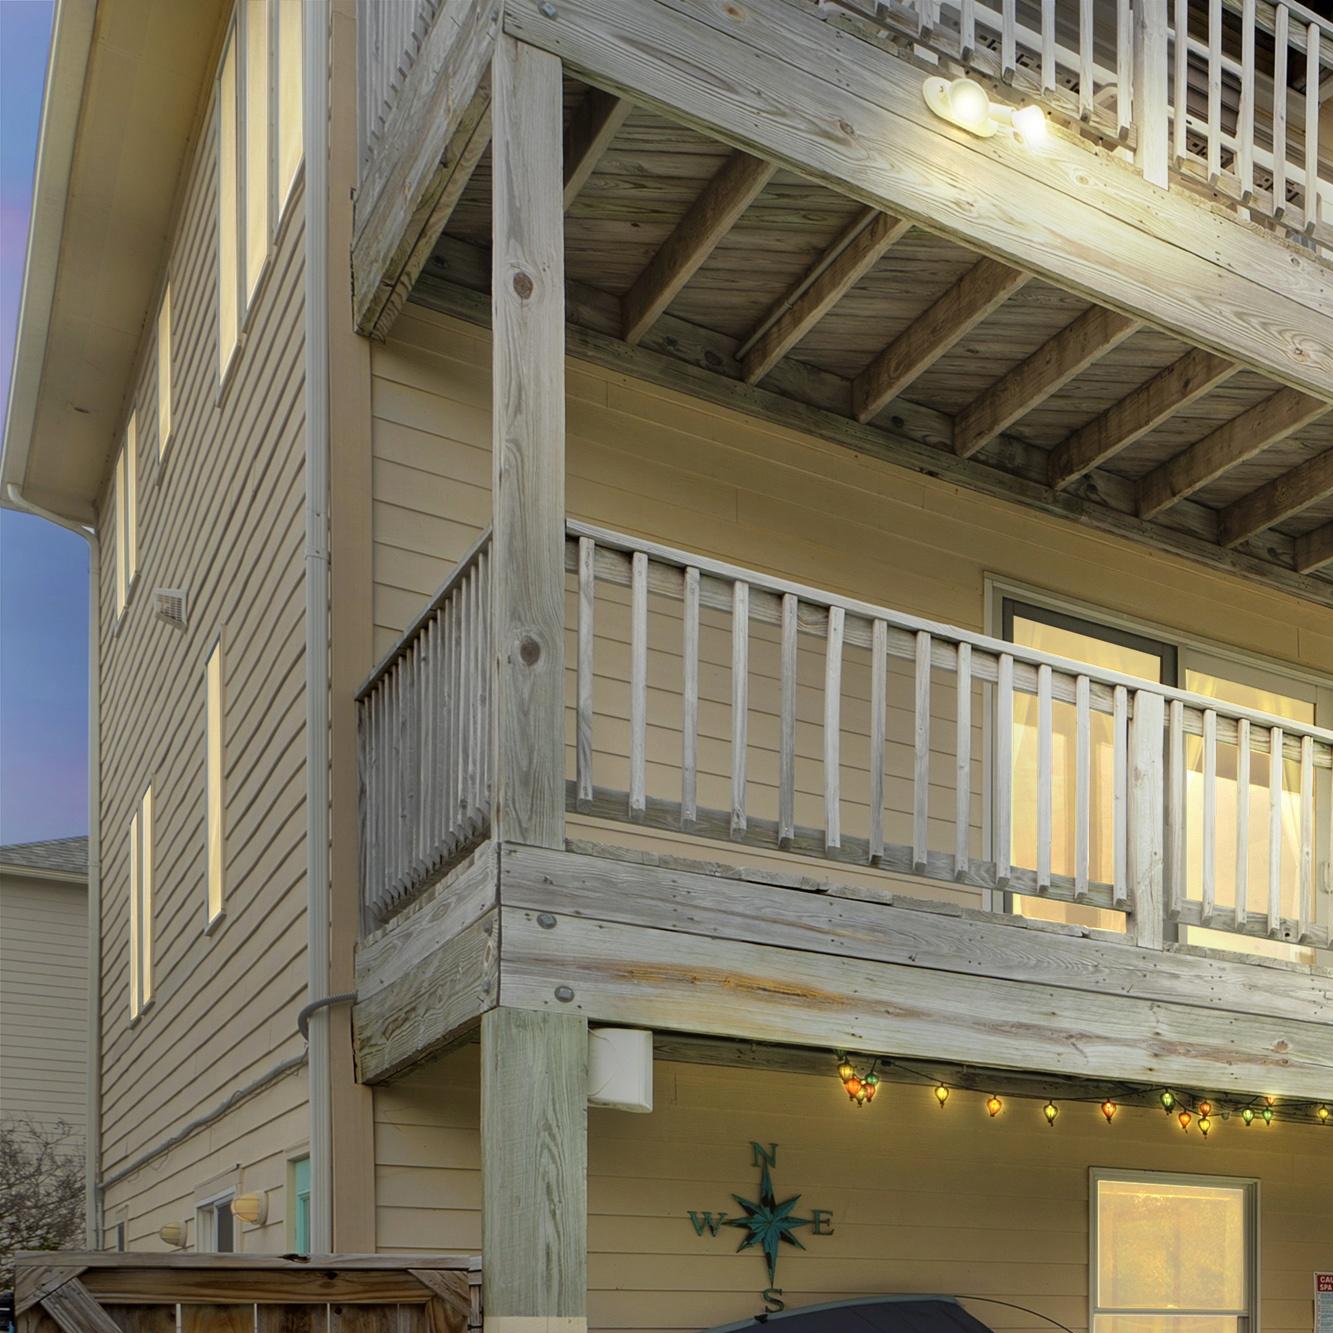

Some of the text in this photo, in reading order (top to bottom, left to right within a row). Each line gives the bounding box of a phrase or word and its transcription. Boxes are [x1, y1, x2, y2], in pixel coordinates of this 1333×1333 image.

[749, 1141, 778, 1168] N
[687, 1211, 728, 1237] W
[811, 1209, 835, 1235] E
[762, 1287, 785, 1313] S
